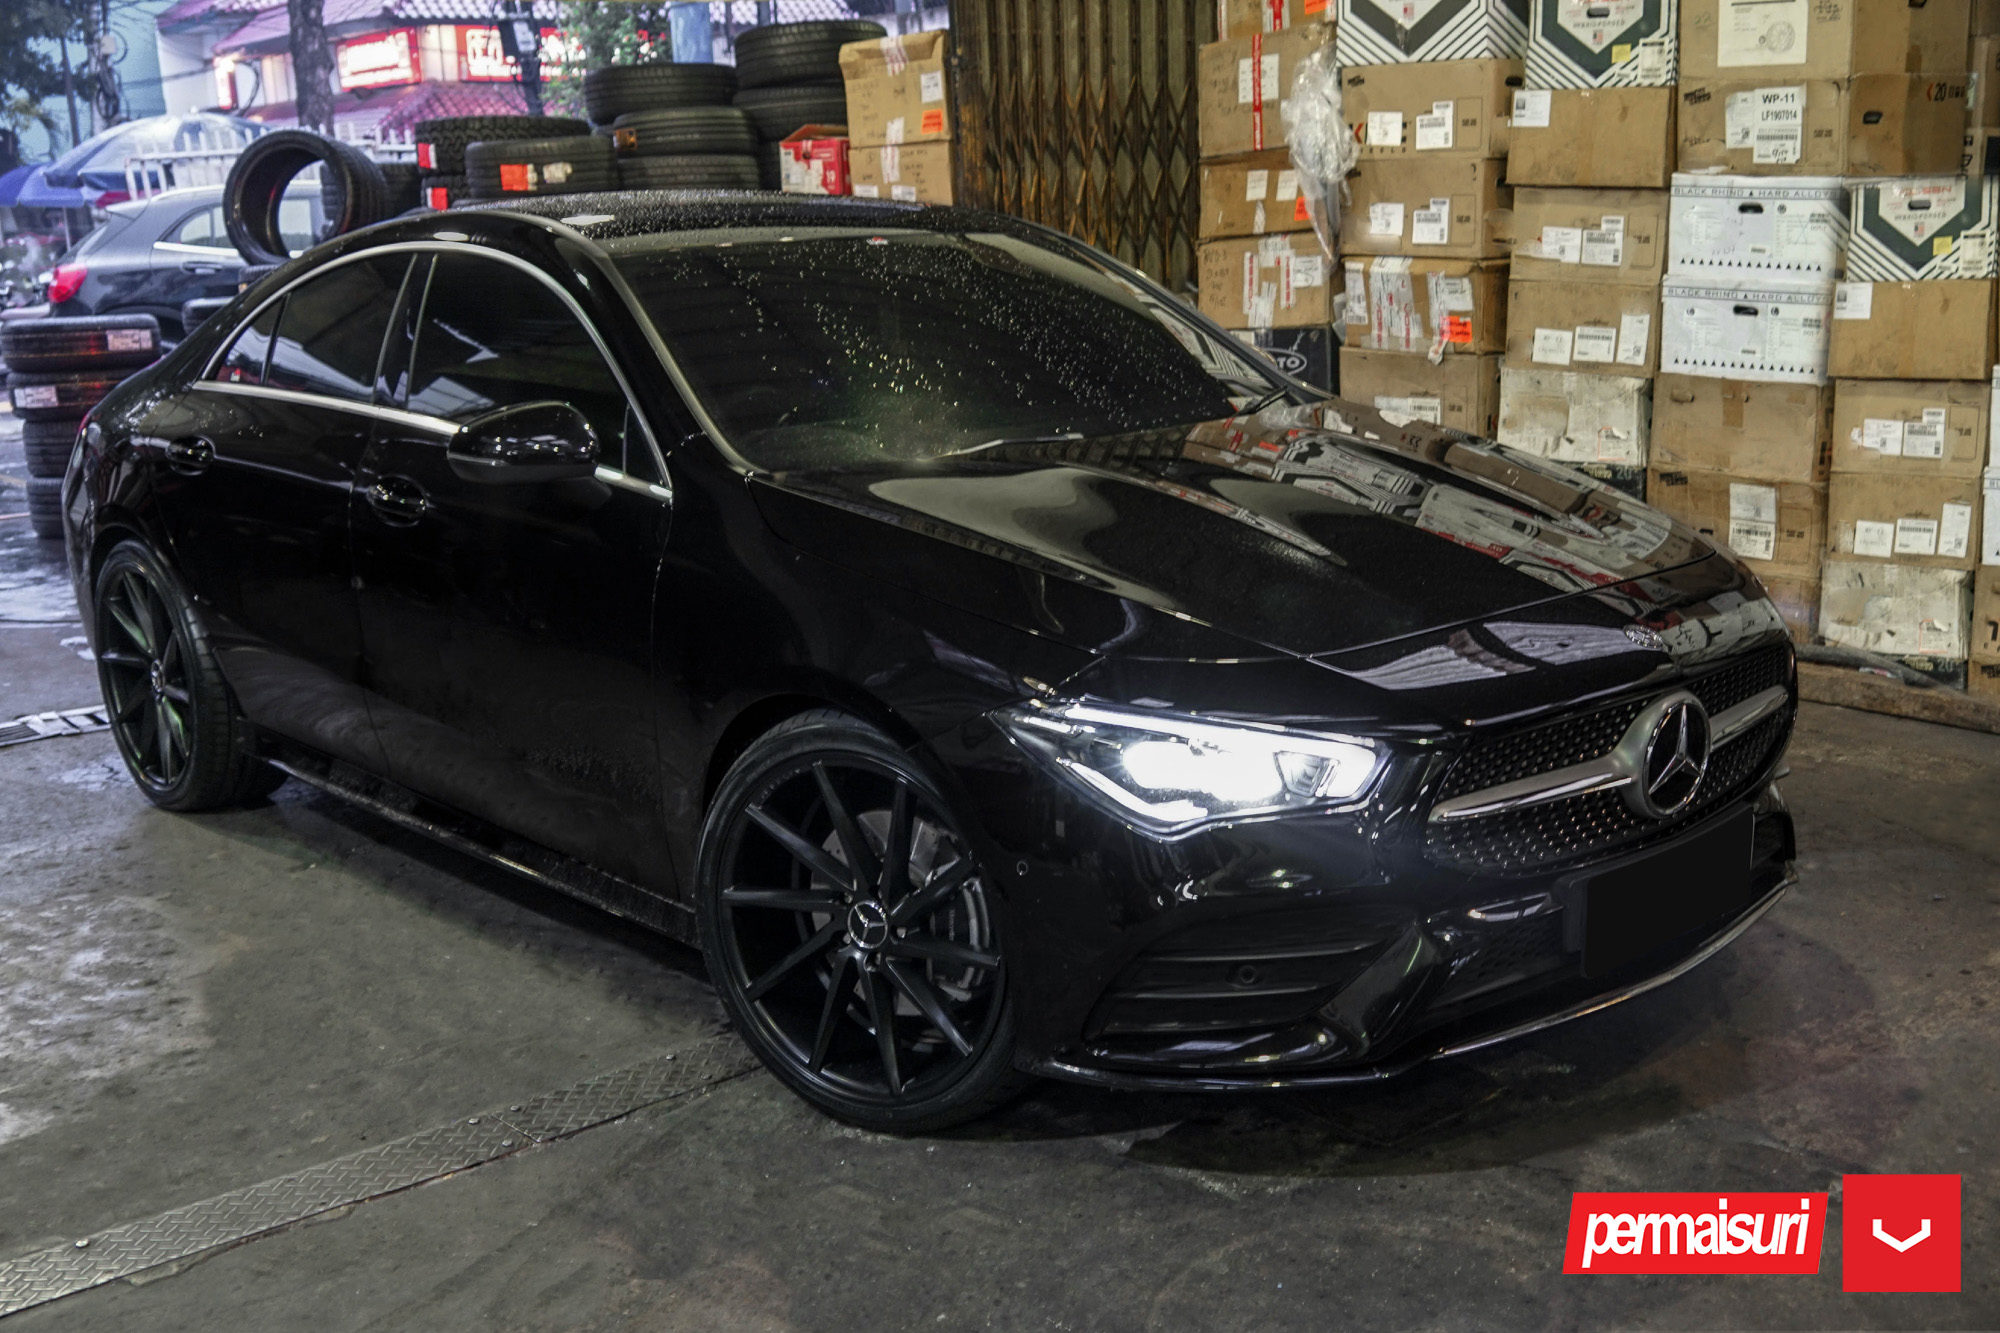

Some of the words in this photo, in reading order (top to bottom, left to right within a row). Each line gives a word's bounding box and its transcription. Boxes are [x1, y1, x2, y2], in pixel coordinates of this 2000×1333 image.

[1762, 93, 1795, 104] WP-11
[1762, 110, 1797, 121] LF1907014
[1674, 187, 1707, 196] BLACK
[1711, 188, 1744, 197] RHINO
[1758, 190, 1790, 198] HARD
[1667, 287, 1699, 296] BLACK
[1704, 289, 1738, 299] RHINO
[1752, 293, 1782, 301] HARD
